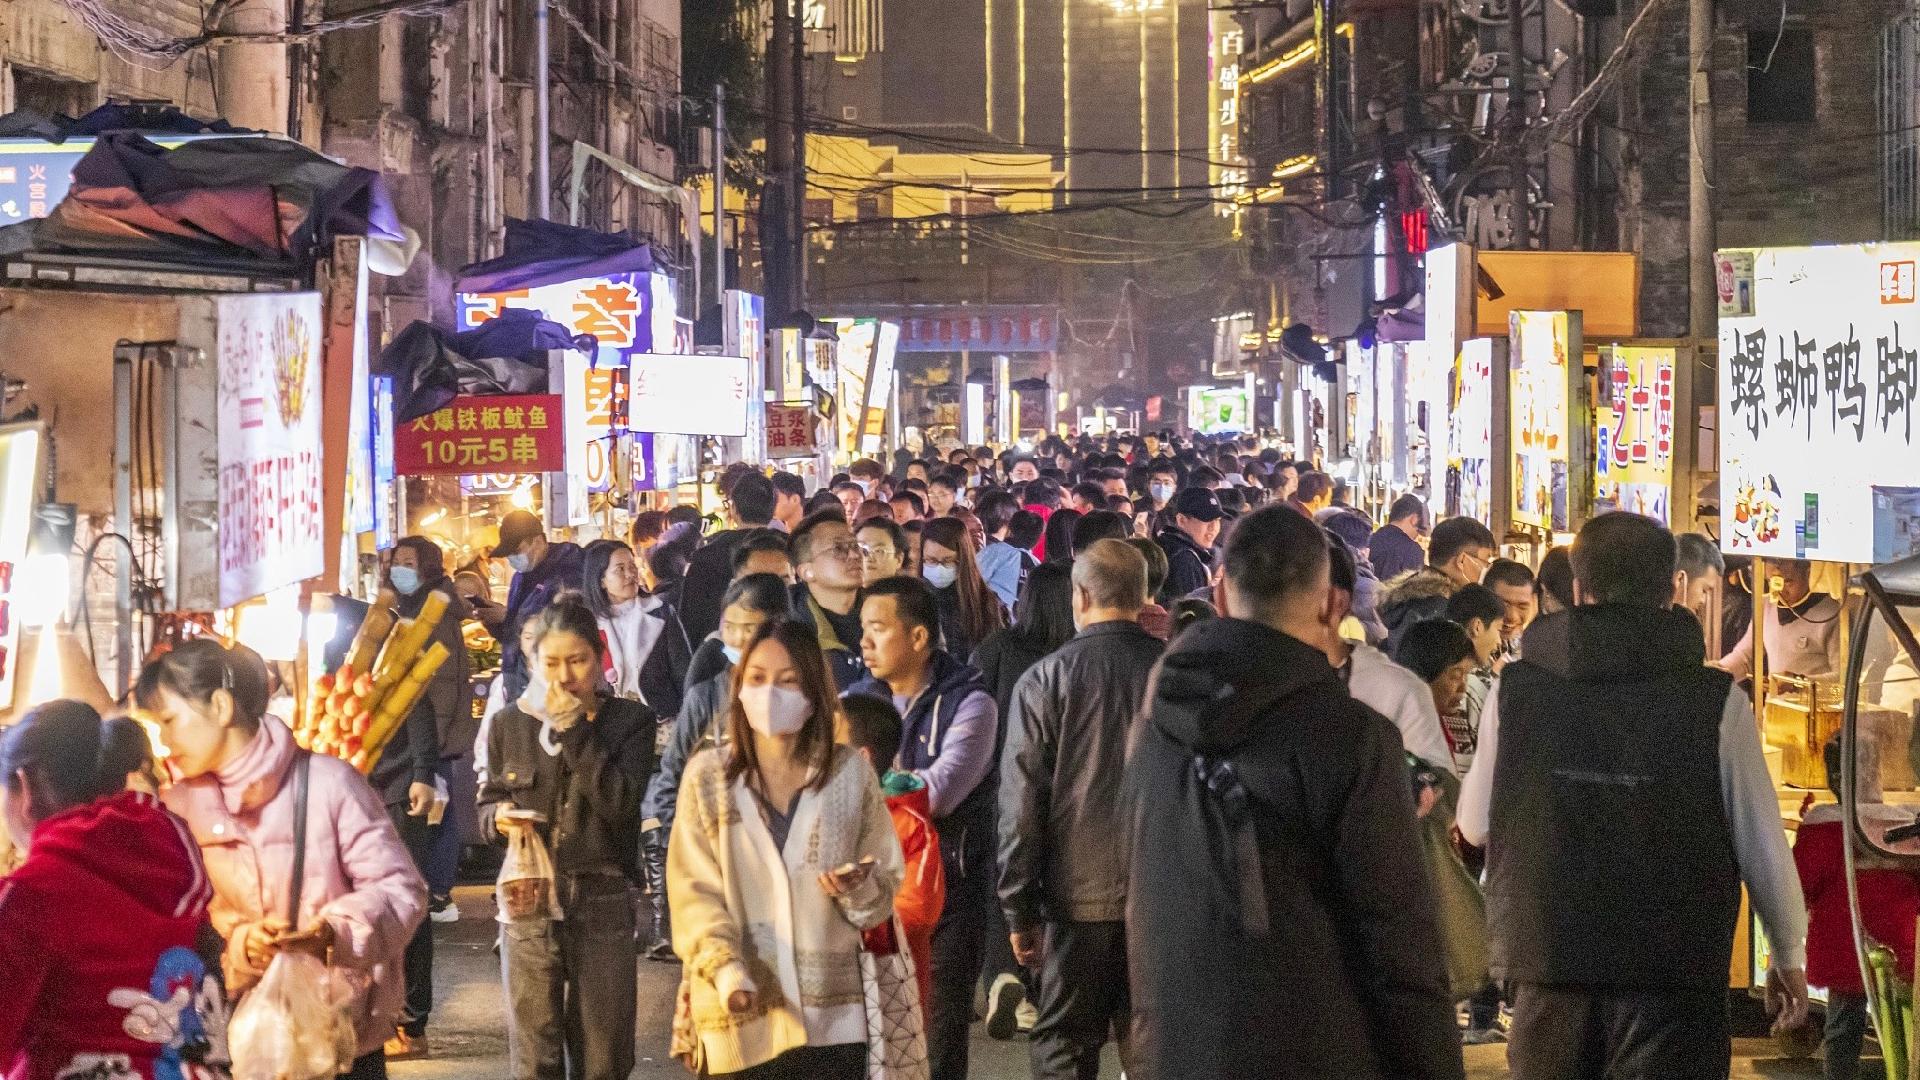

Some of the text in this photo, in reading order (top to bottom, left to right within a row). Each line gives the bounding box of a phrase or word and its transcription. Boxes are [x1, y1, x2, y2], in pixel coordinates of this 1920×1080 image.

[1730, 320, 1918, 446] 螺蛳鸭脚
[411, 405, 548, 432] 火爆铁板鱿鱼
[421, 433, 539, 466] 10元5串
[769, 429, 806, 446] 油条
